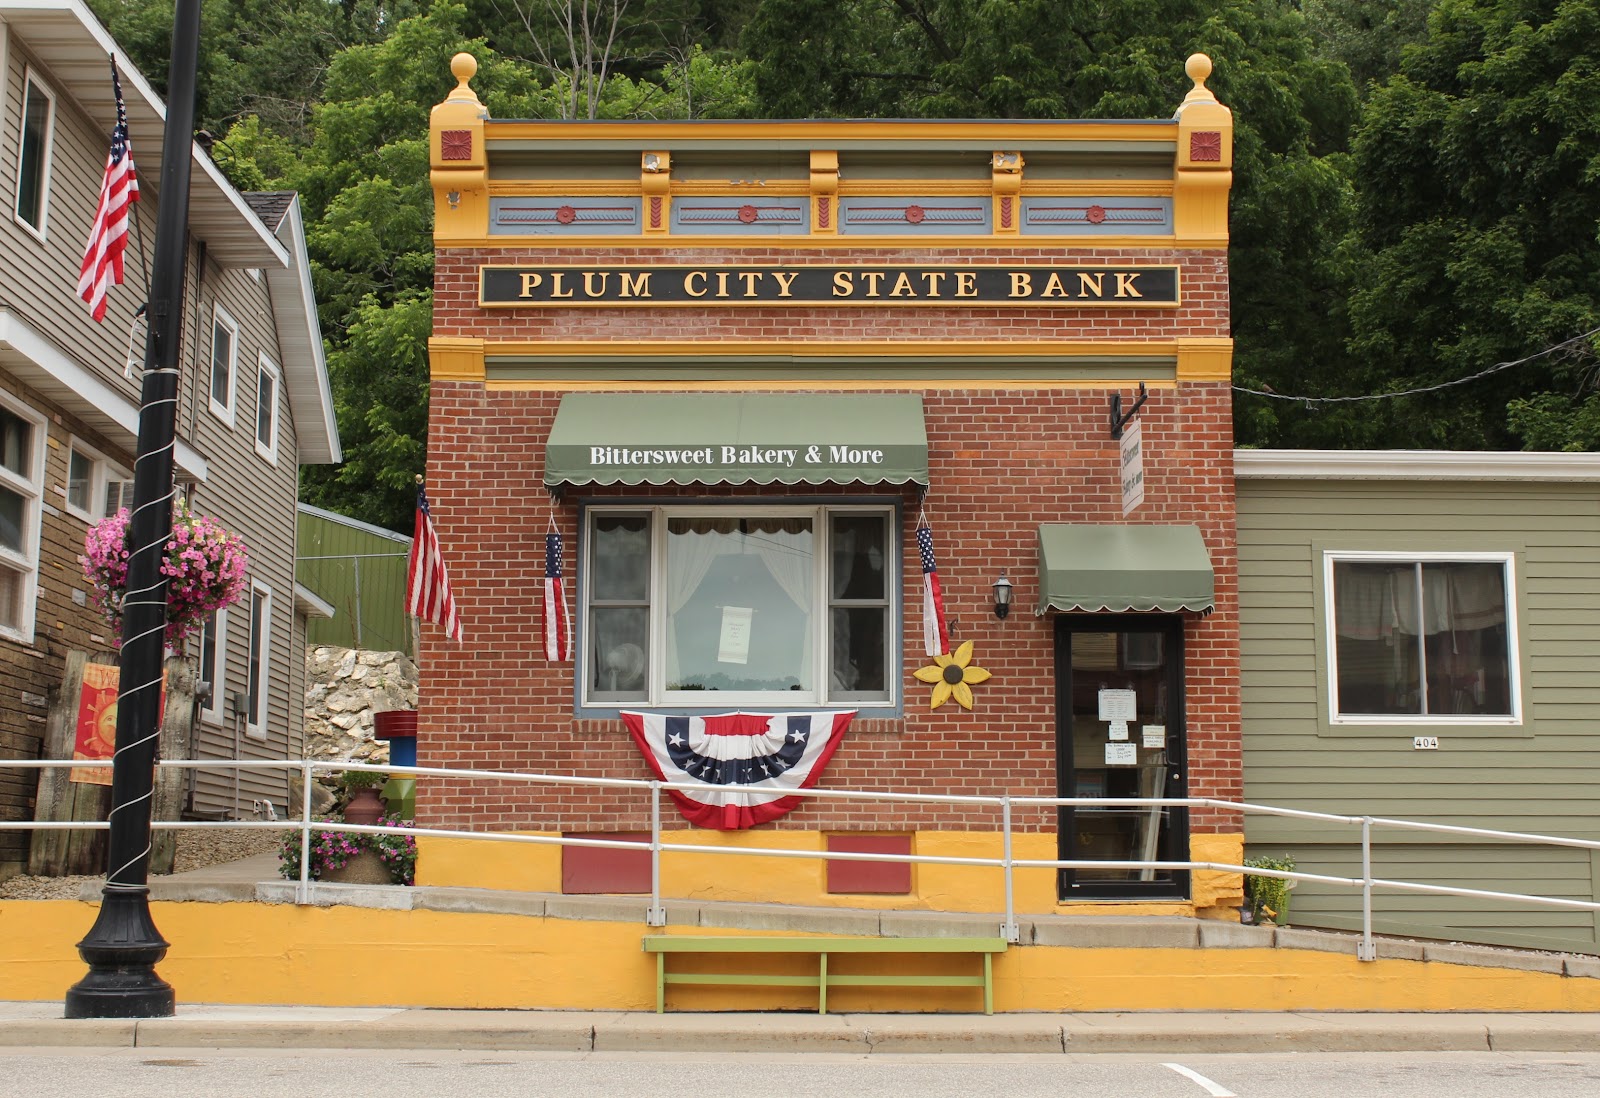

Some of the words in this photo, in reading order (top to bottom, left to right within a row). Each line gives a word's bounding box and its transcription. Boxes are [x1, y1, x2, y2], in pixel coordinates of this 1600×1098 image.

[519, 272, 653, 298] PLUM
[683, 271, 800, 298] CITY
[832, 271, 979, 298] STATE
[1008, 272, 1144, 298] BANK
[590, 446, 715, 465] Bittersweet
[721, 445, 798, 468] Bakery
[804, 445, 822, 464] &
[828, 445, 884, 464] More
[1415, 738, 1437, 748] 404
